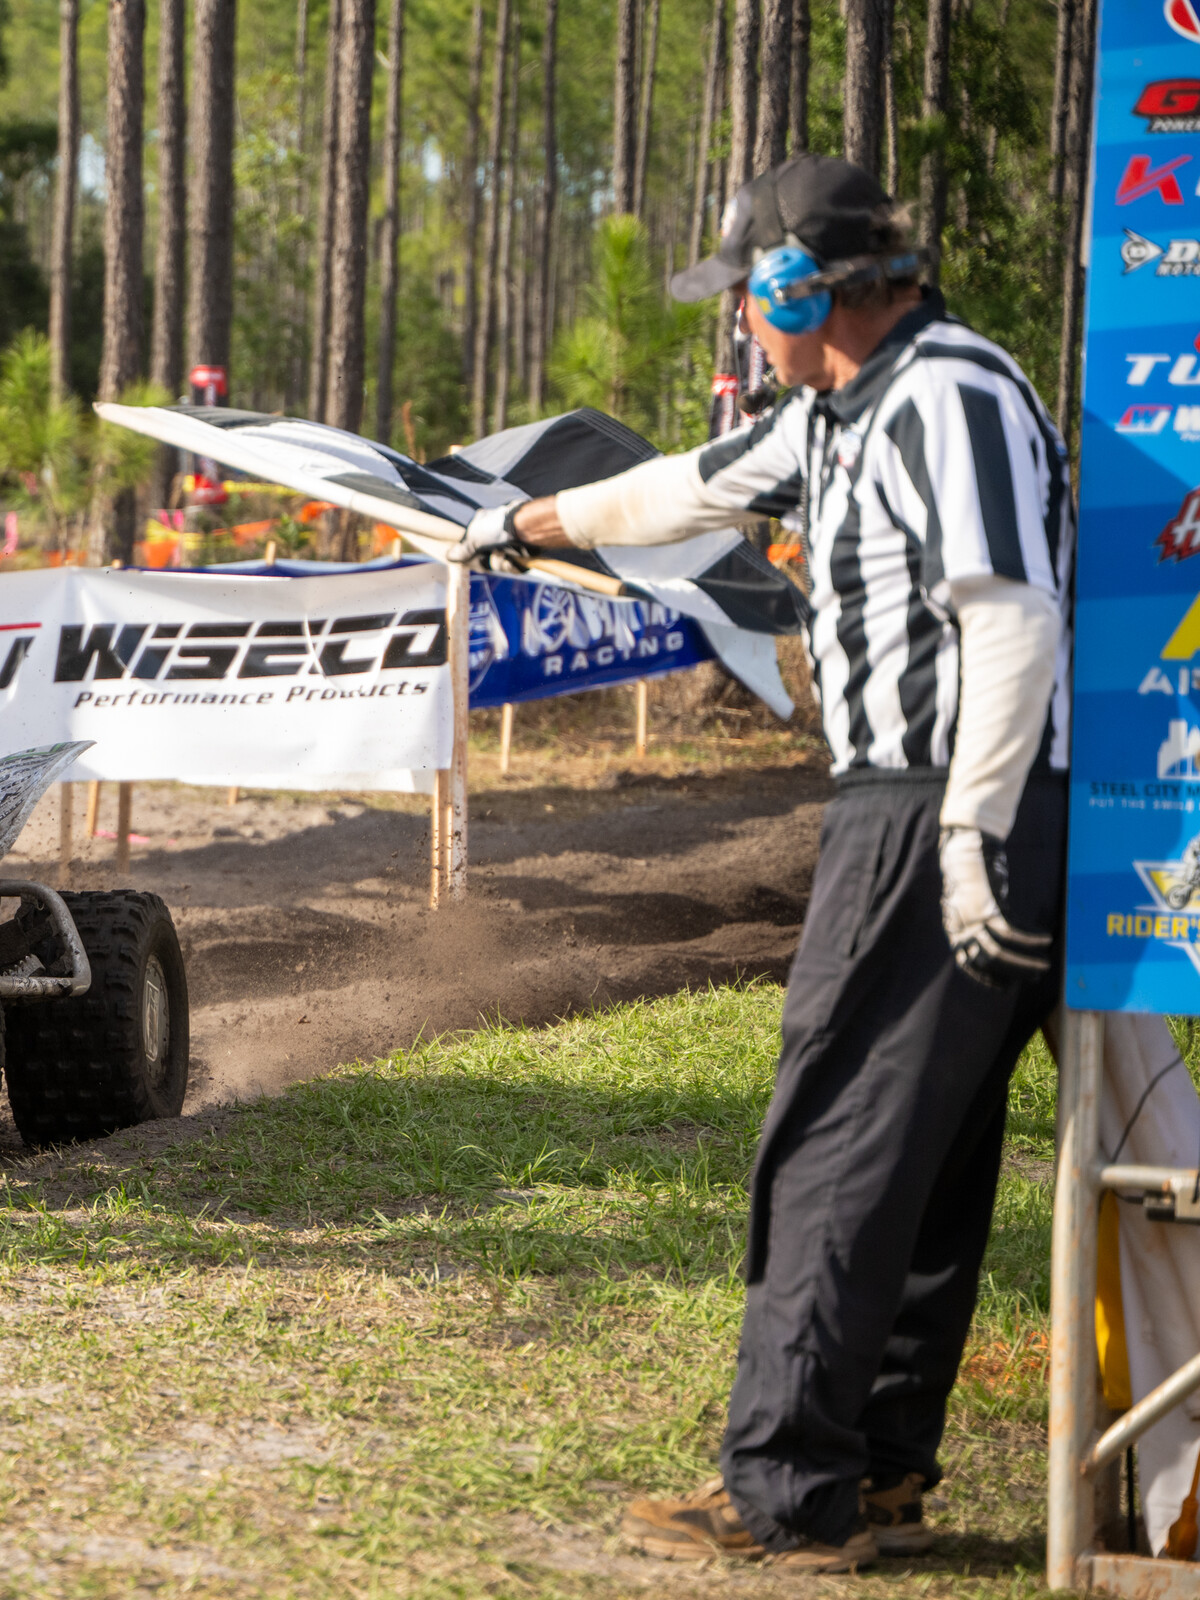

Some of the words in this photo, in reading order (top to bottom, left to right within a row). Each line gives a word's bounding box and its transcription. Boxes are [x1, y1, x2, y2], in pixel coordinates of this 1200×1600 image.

[1131, 79, 1200, 118] G
[1163, 238, 1200, 263] D
[73, 688, 275, 710] Performance
[1090, 782, 1137, 797] STEEL
[1143, 783, 1180, 798] CITY
[1106, 912, 1200, 938] RIDER'
